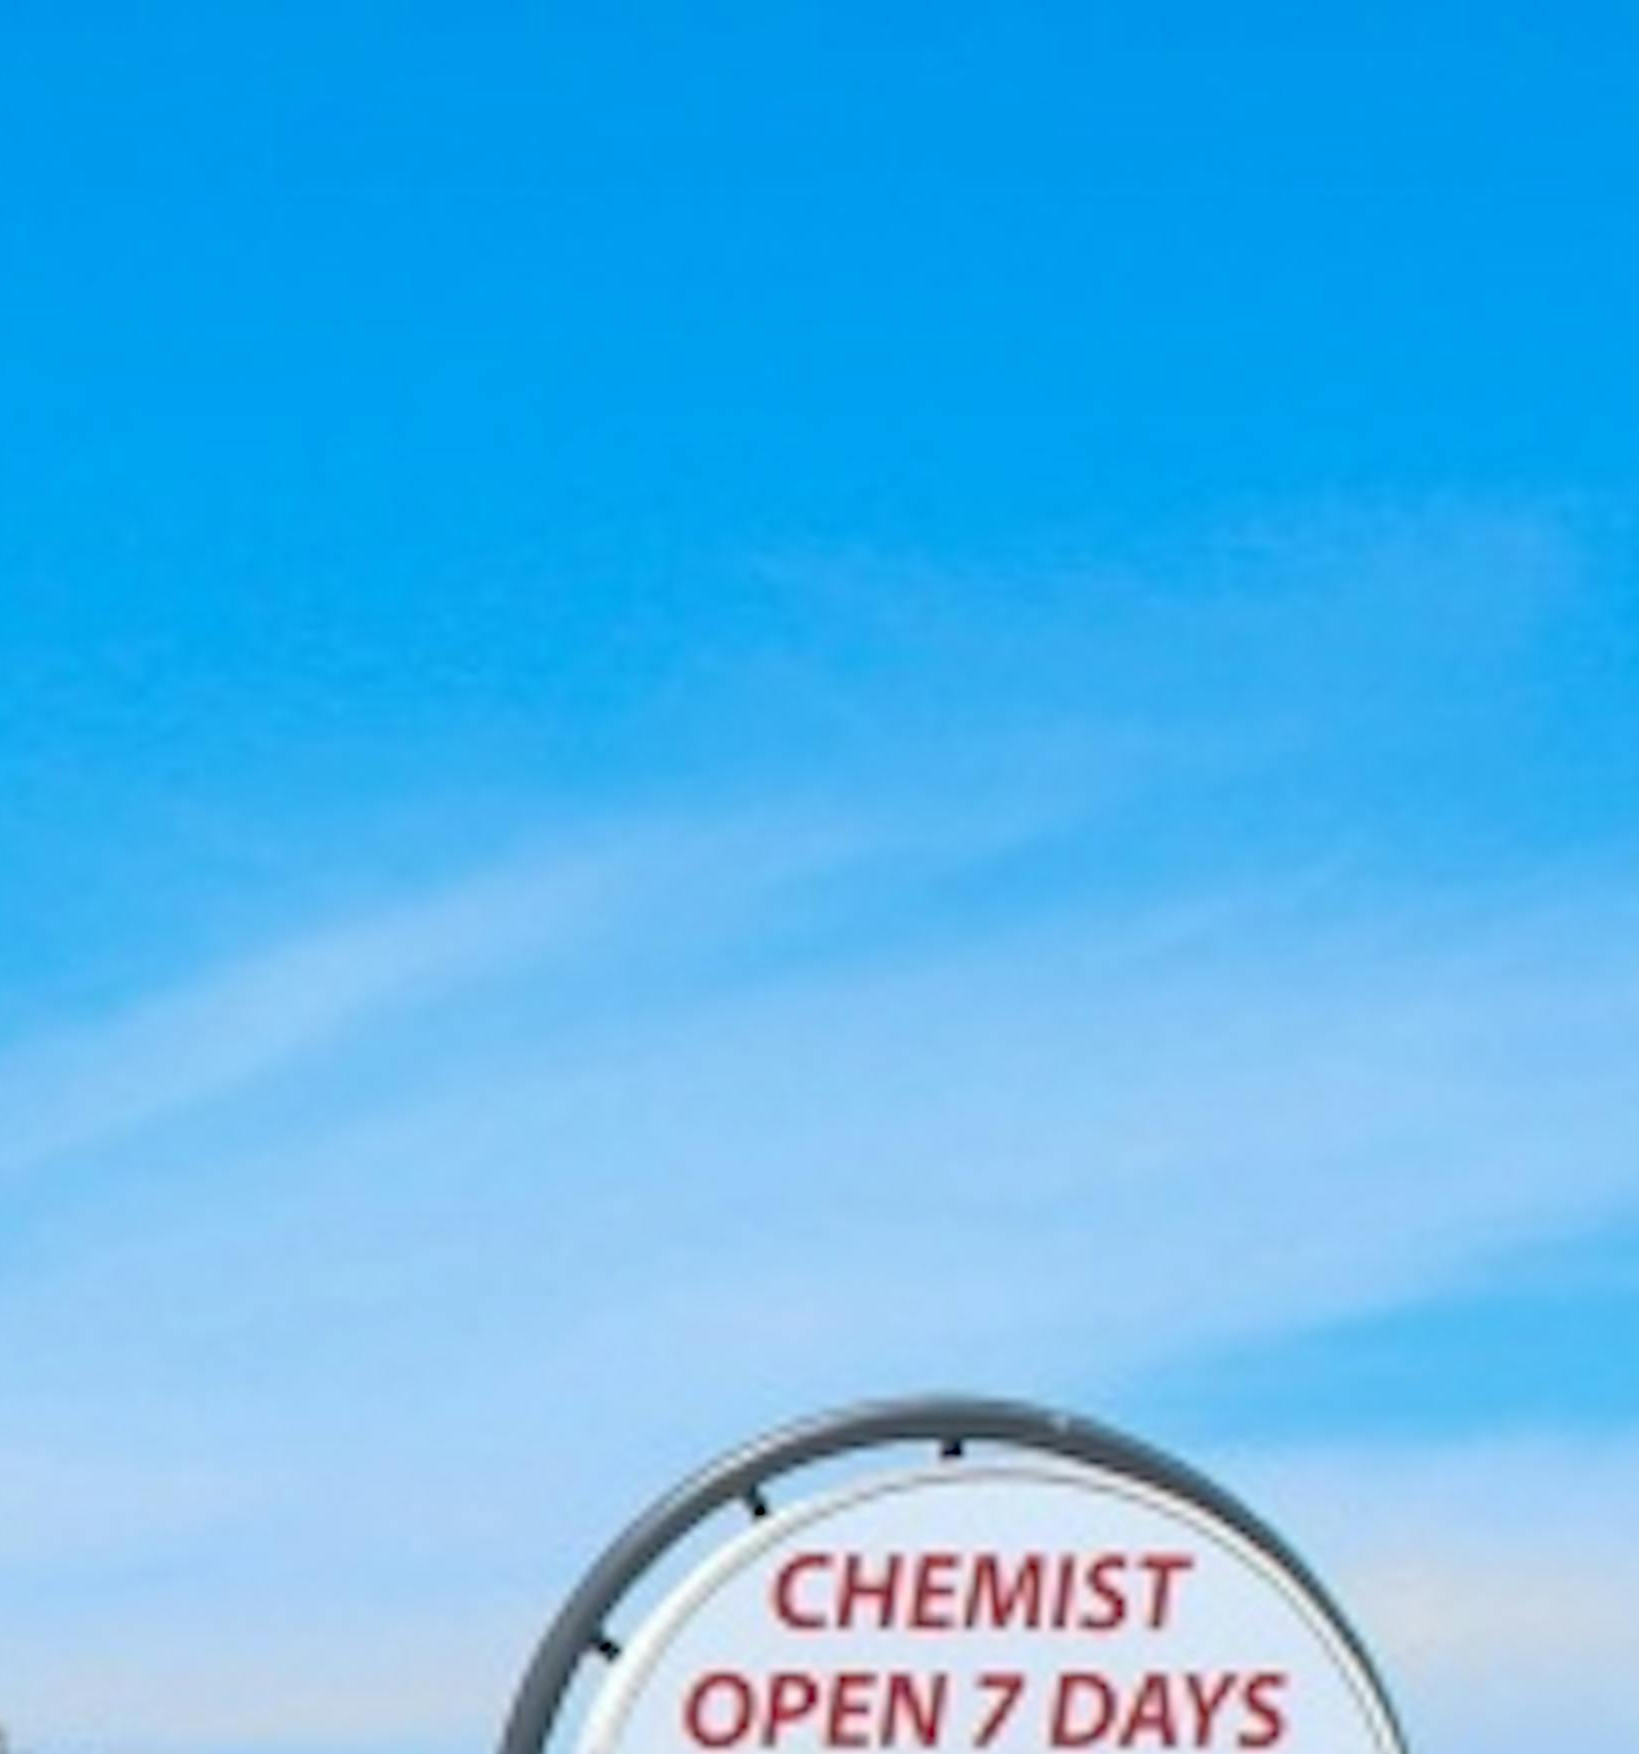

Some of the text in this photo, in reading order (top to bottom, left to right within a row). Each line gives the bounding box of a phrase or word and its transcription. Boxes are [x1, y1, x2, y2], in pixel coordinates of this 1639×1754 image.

[771, 1552, 1195, 1632] CHEMIST
[682, 1672, 1289, 1751] OPEN 7 DAYS
